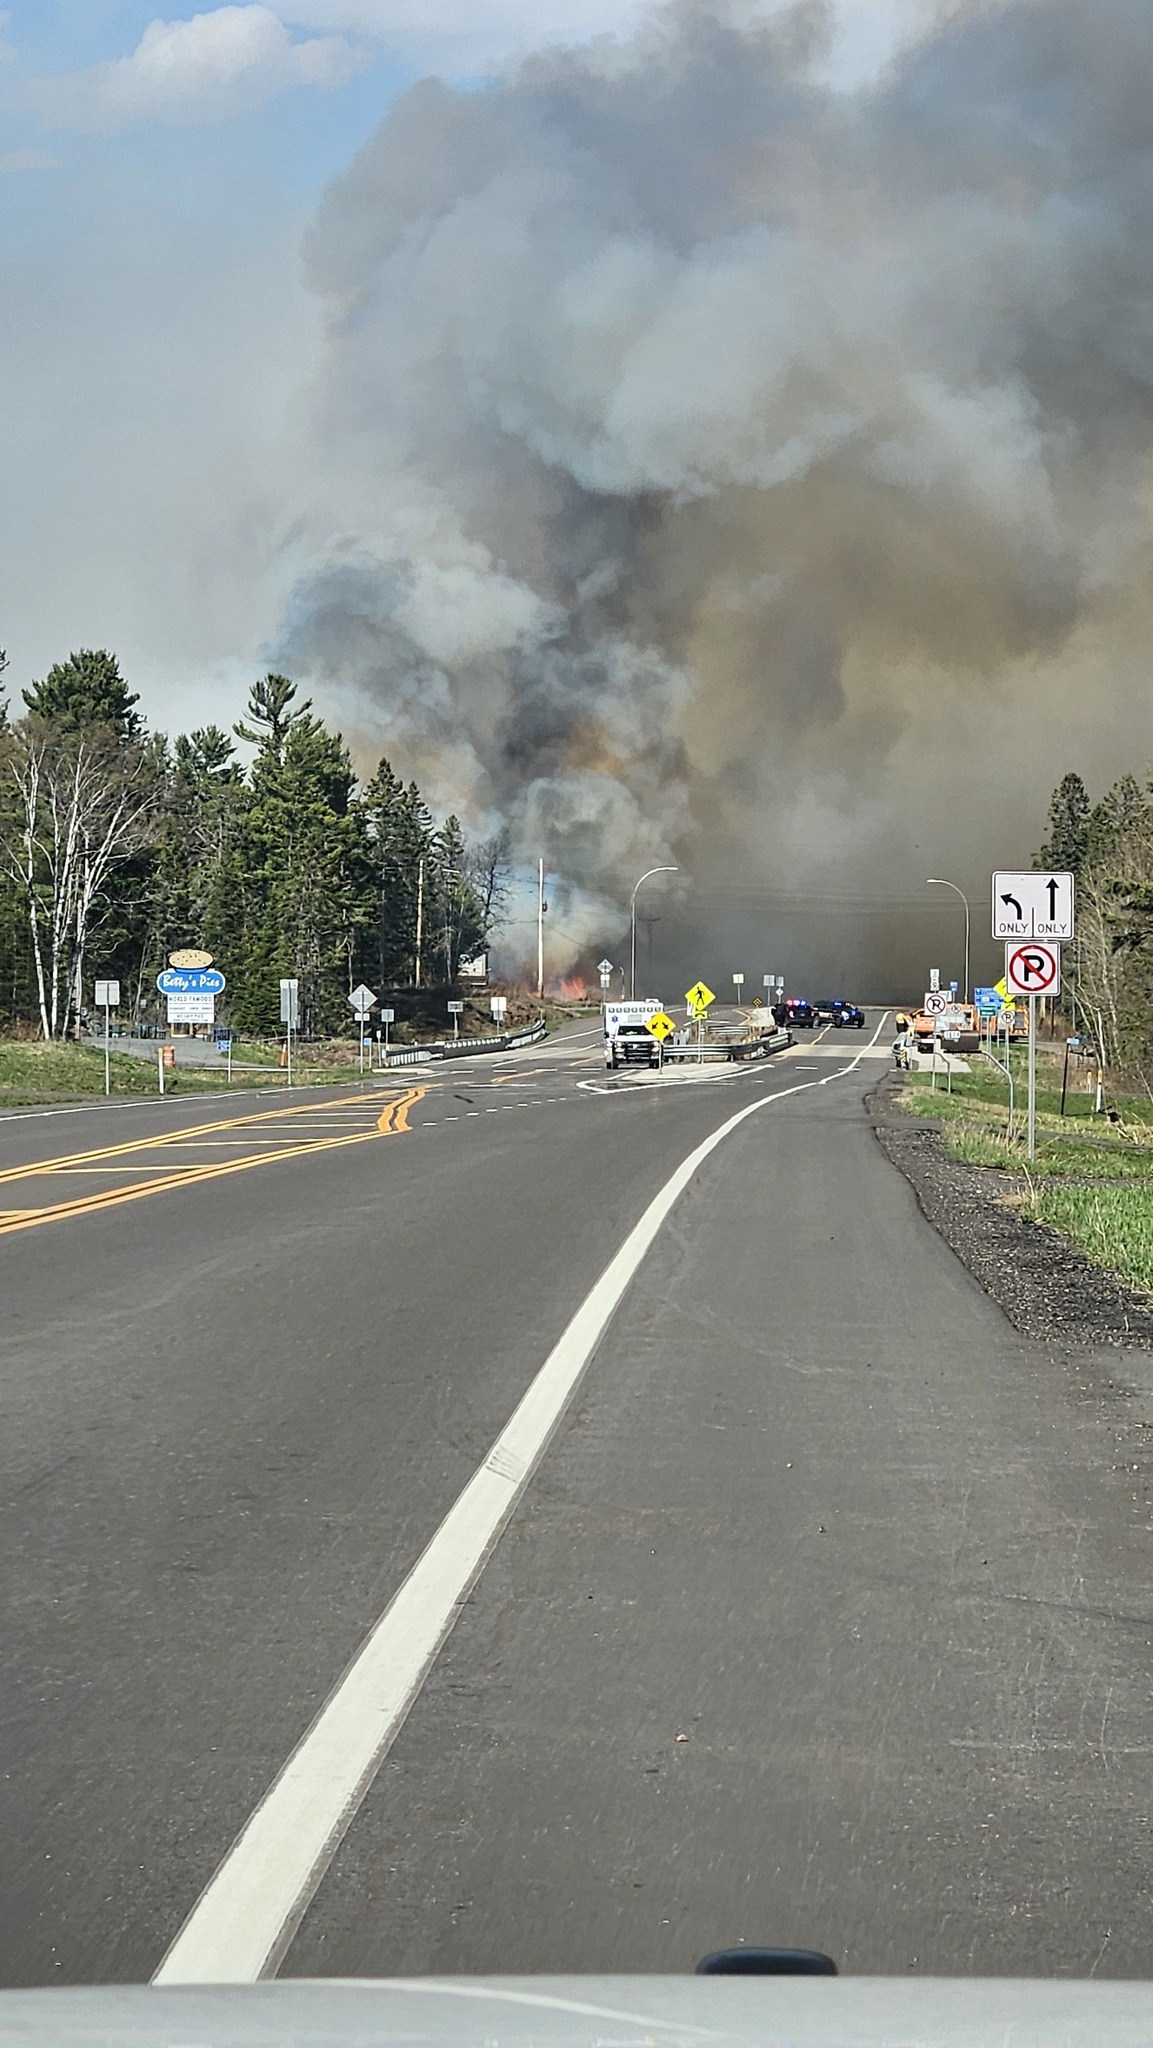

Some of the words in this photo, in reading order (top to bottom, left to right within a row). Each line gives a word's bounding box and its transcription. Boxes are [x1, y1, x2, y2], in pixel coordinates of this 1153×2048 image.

[999, 923, 1029, 933] ONLY
[1037, 923, 1067, 934] ONLY
[1023, 955, 1044, 982] P
[163, 974, 197, 991] Betty's
[199, 974, 220, 988] Pies
